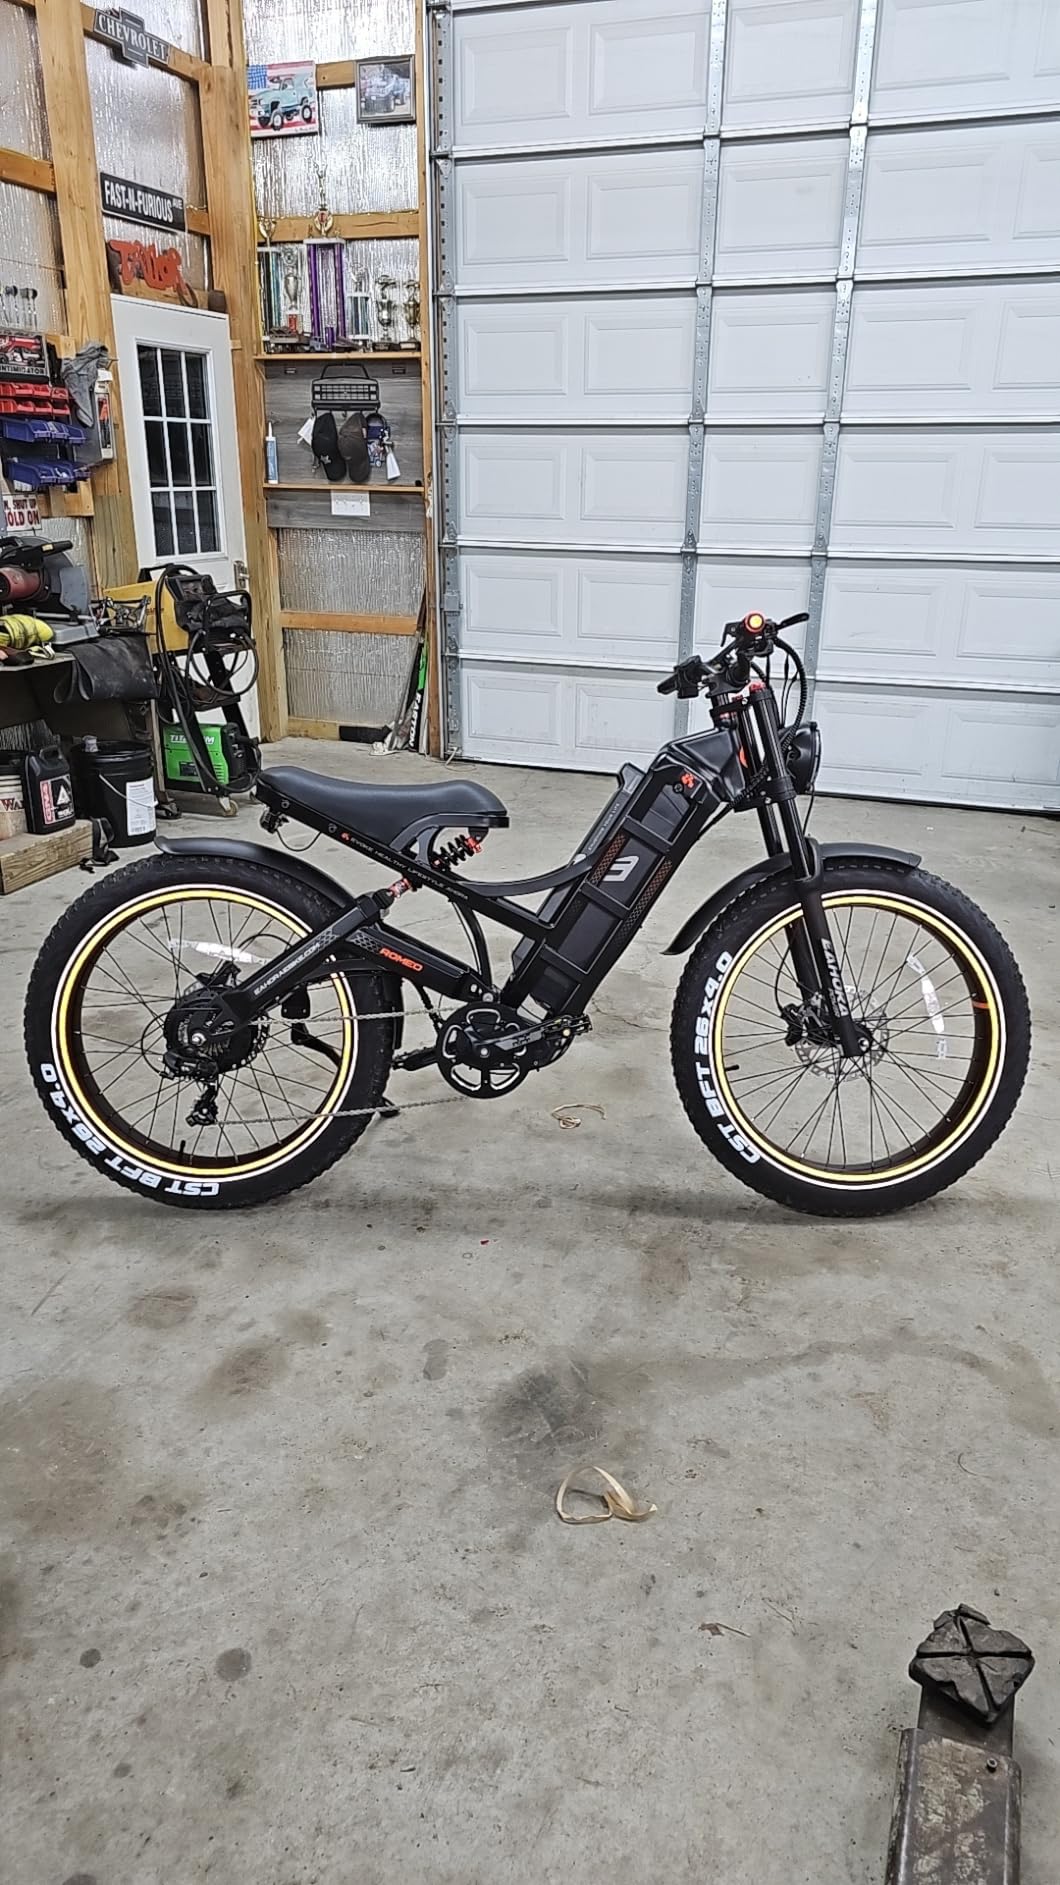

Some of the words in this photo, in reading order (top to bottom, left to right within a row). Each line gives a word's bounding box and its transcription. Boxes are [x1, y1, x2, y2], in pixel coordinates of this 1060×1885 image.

[98, 15, 167, 61] CHEVROLET
[104, 180, 174, 223] FAST-N-FURIOUS
[0, 364, 45, 375] NTIMIDATOR
[6, 511, 25, 527] OLD
[27, 510, 40, 526] ON
[170, 734, 215, 745] TITAM
[379, 947, 424, 972] ROMEO
[821, 938, 849, 1017] EAHORA
[695, 1061, 724, 1118] BFT
[717, 1122, 761, 1164] CST
[104, 1156, 162, 1189] BFT
[164, 1181, 220, 1196] CST
